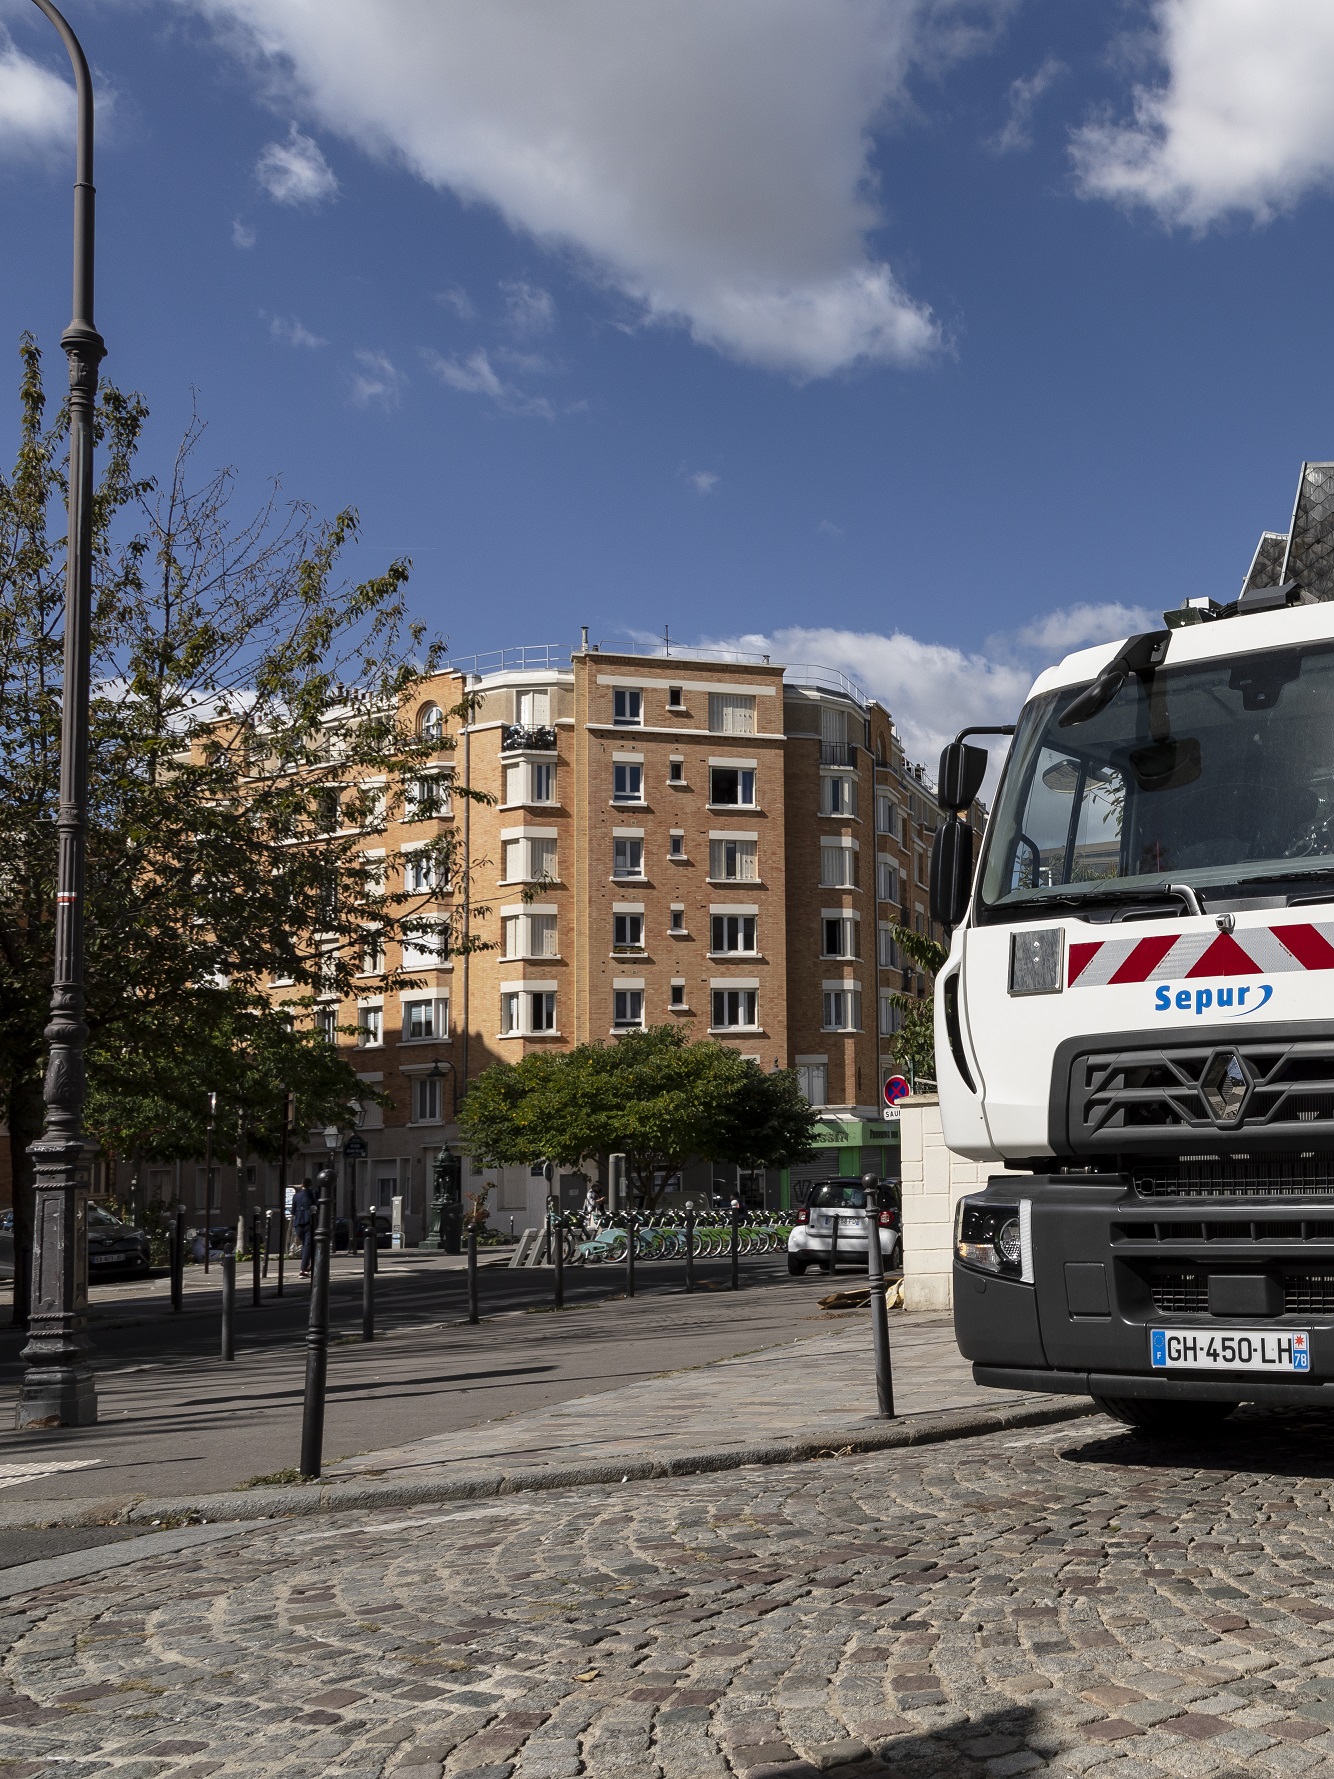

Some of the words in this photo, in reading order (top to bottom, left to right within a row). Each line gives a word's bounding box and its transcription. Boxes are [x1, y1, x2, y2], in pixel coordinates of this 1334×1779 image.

[1155, 985, 1251, 1015] Sepur
[885, 1110, 901, 1118] SAU
[1156, 1351, 1162, 1360] F
[1166, 1335, 1294, 1364] GH-450-LH
[1294, 1353, 1307, 1367] 78
